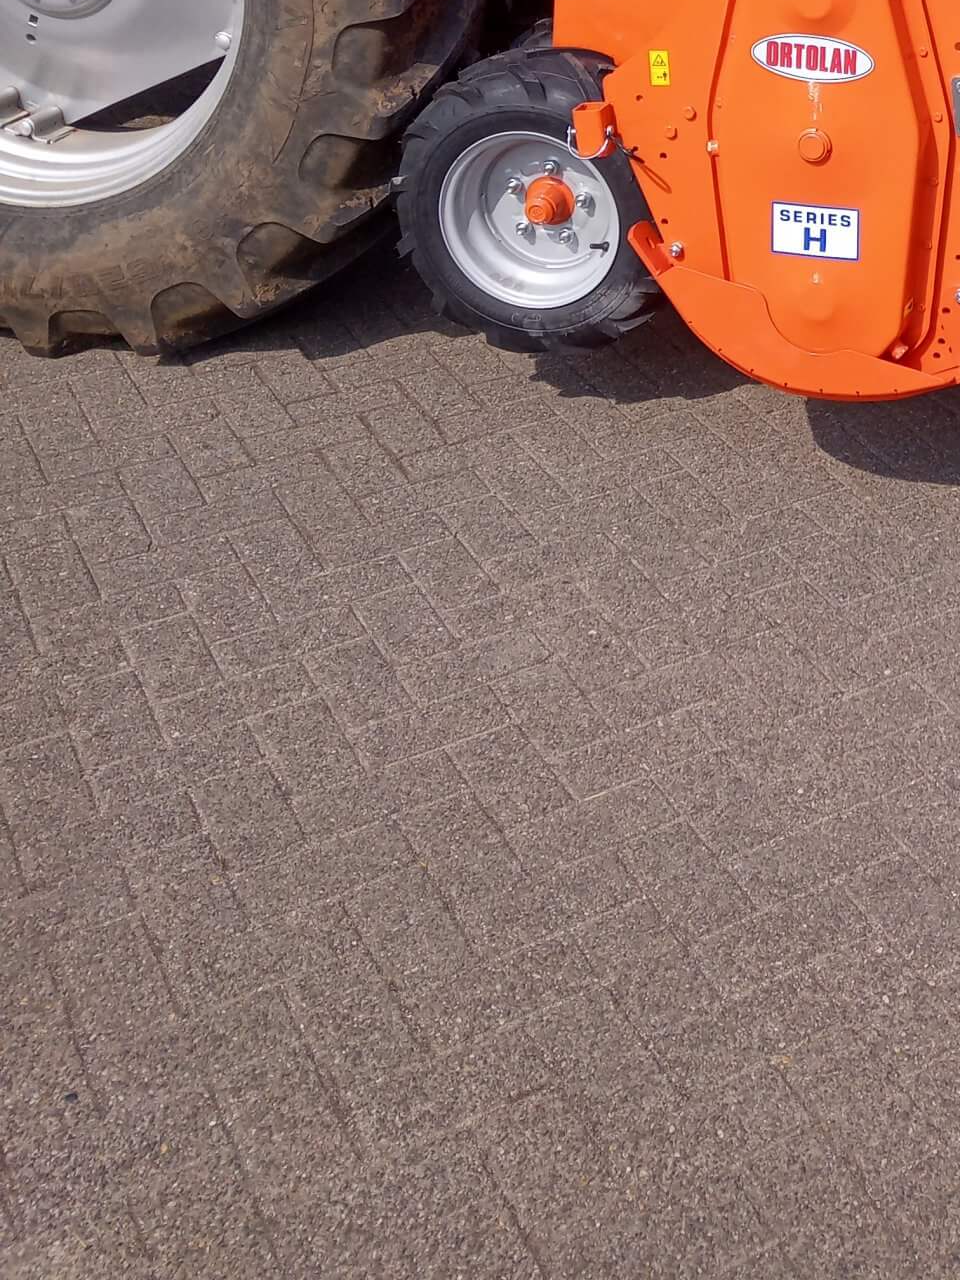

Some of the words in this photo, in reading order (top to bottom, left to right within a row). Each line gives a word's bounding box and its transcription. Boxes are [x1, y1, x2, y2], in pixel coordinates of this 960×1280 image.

[765, 40, 857, 76] ORTOLAN
[779, 210, 852, 227] SERIES
[803, 227, 827, 253] H
